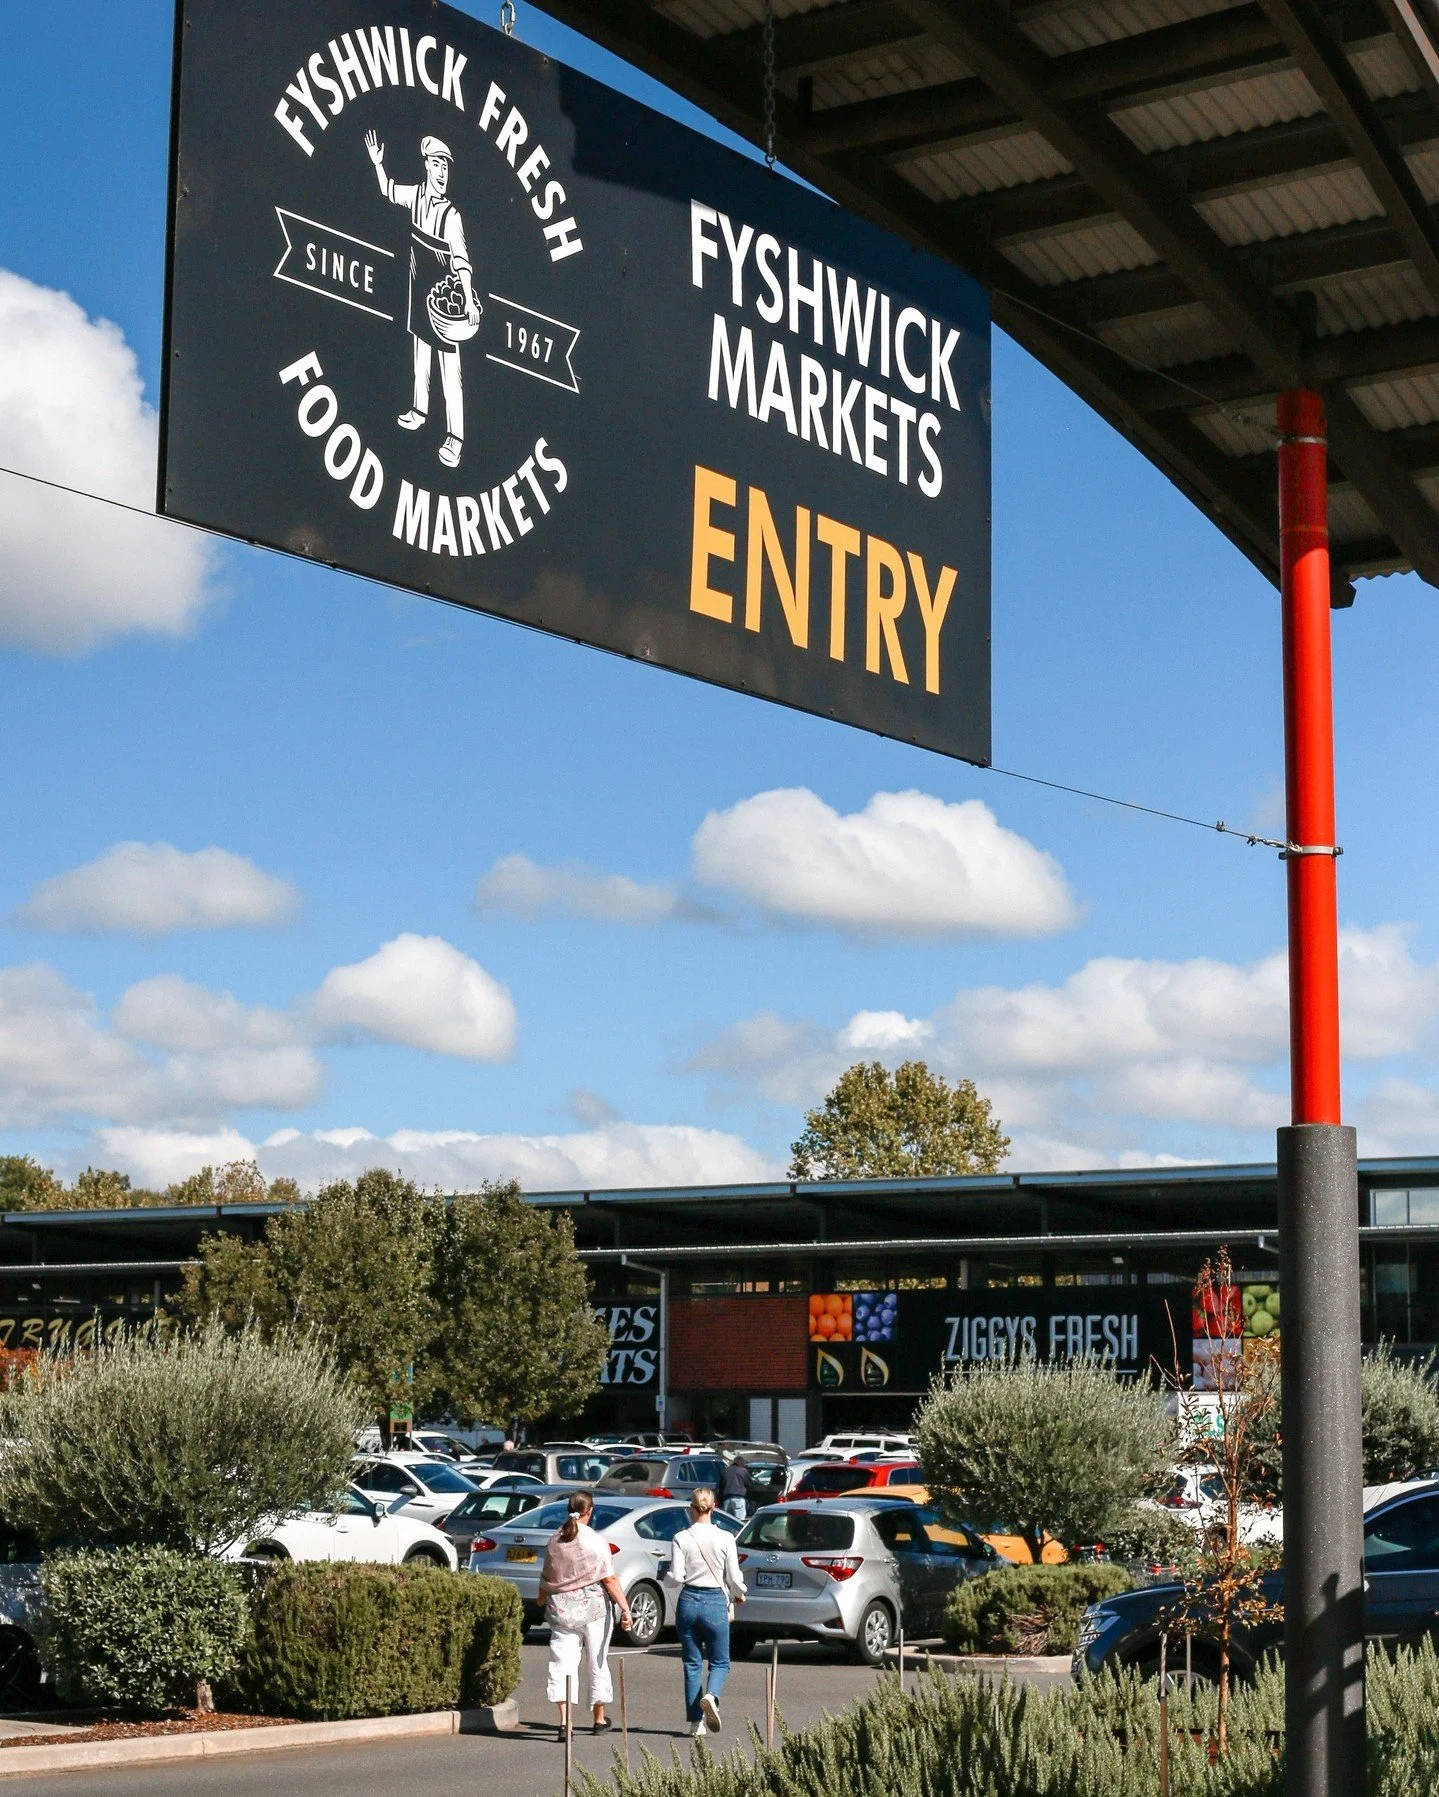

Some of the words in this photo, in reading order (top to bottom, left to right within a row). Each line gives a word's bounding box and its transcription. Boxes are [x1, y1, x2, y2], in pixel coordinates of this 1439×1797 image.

[273, 26, 468, 157] FYSHWICK
[479, 81, 584, 262] FRESH
[306, 243, 374, 293] SINCE
[505, 322, 554, 363] 1967
[690, 199, 961, 412] FYSHWICK
[279, 351, 384, 510] FOOD
[393, 437, 568, 557] MARKETS
[707, 313, 943, 498] MARKETS
[690, 465, 959, 695] ENTRY
[594, 1306, 657, 1343] ES
[945, 1316, 1038, 1362] ZIGGYS
[1050, 1314, 1138, 1361] FRESH
